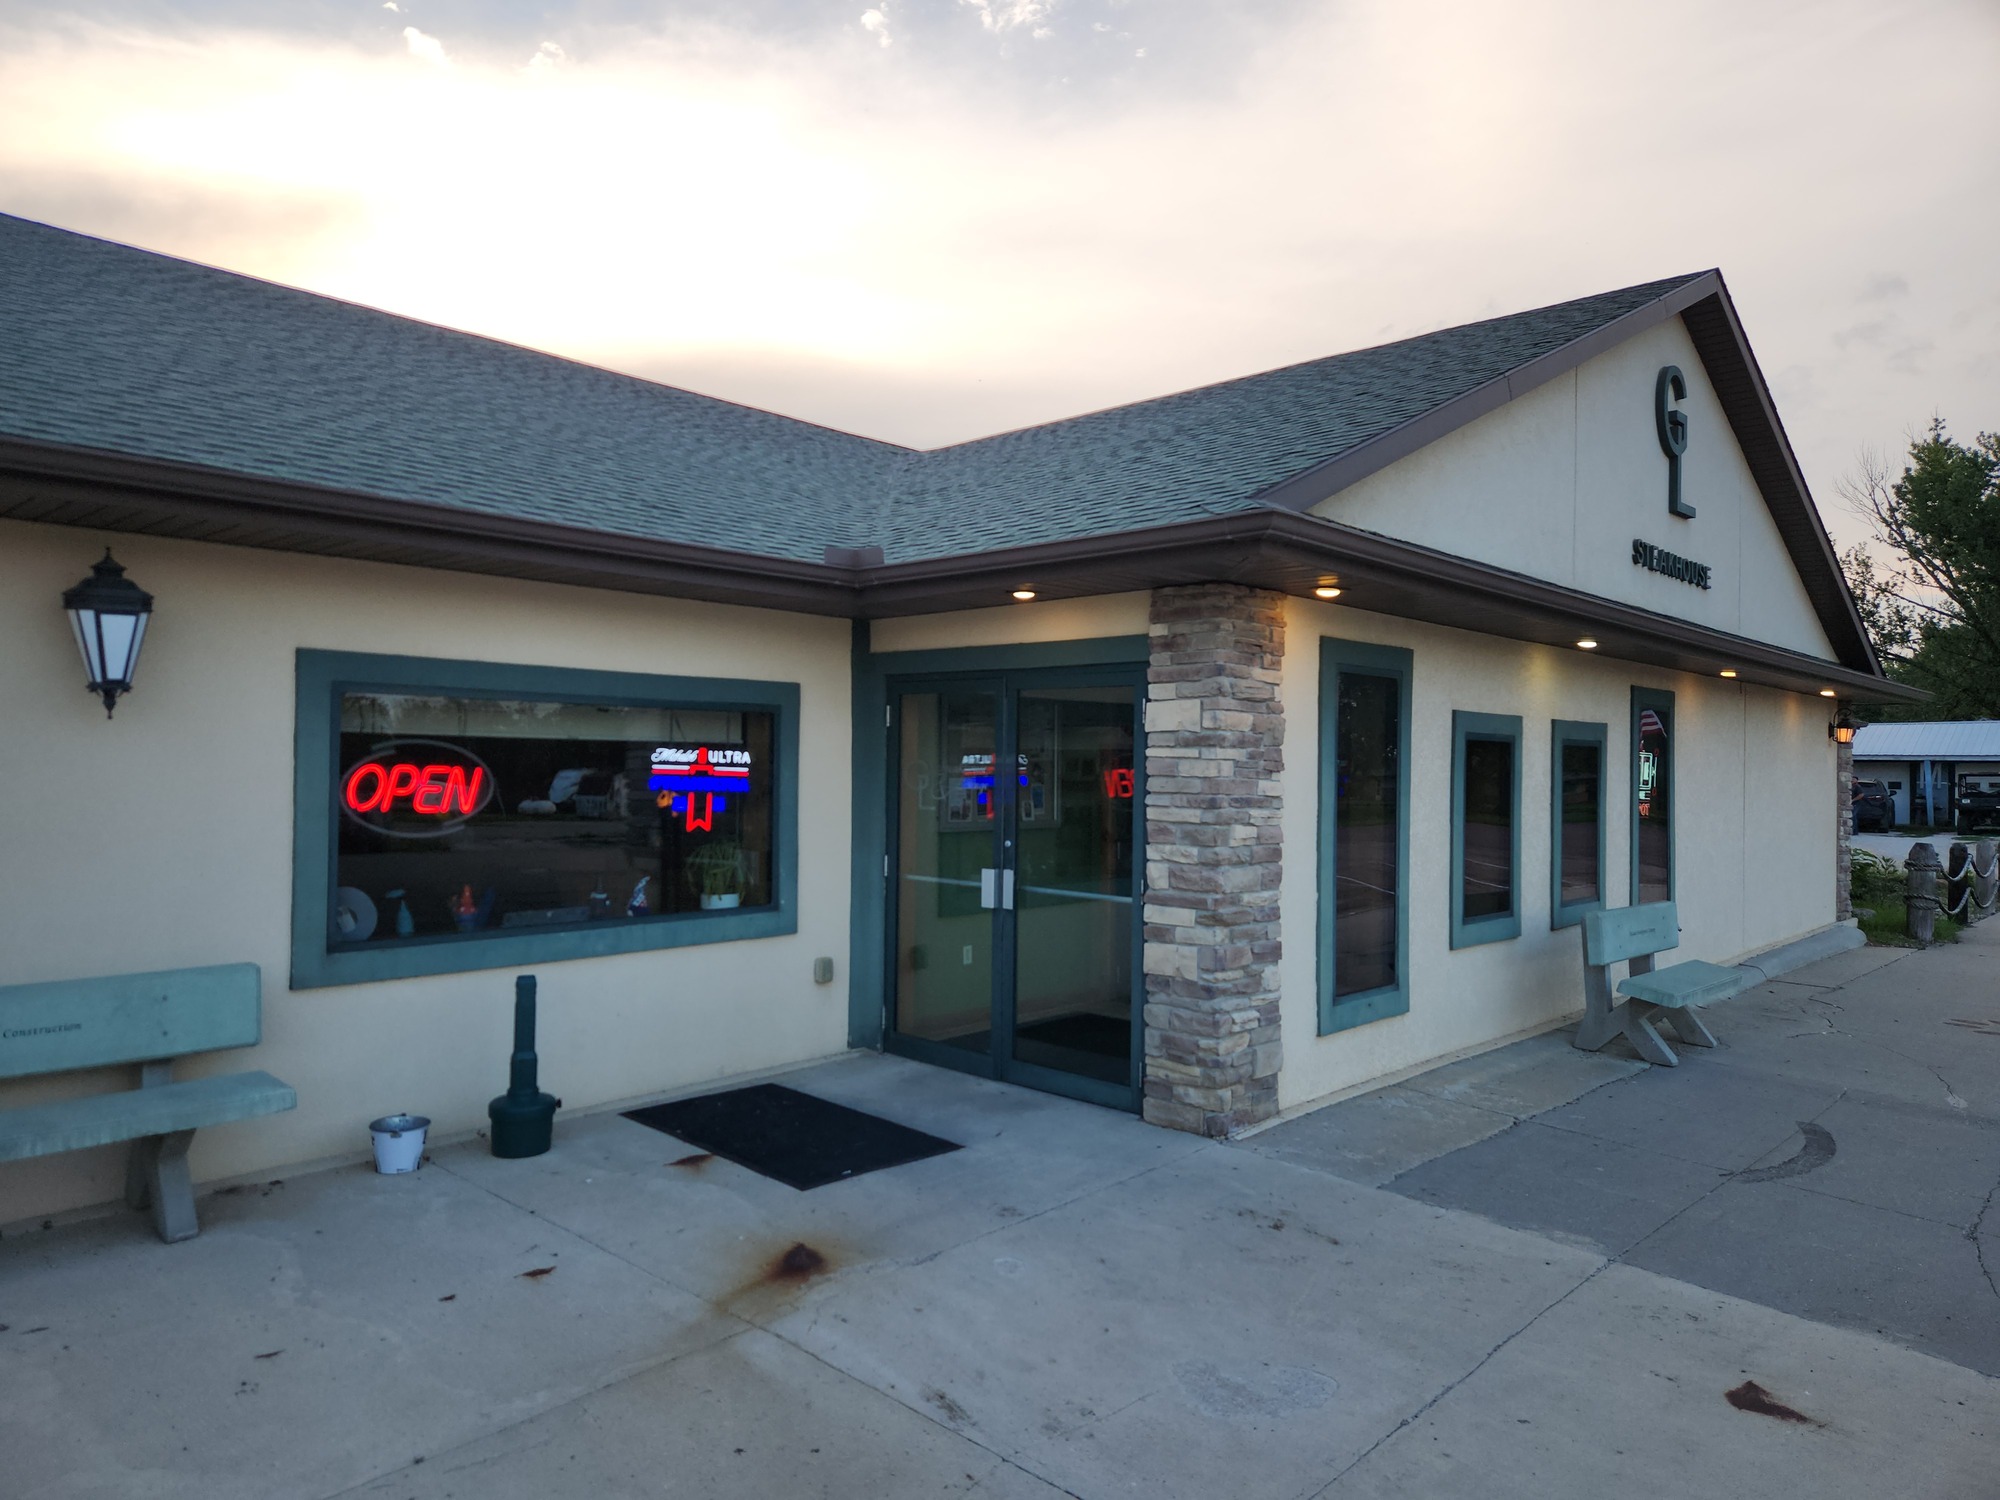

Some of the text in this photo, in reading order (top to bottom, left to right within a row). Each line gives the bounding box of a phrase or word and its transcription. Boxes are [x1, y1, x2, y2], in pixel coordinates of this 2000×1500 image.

[1632, 539, 1712, 590] STEAKHOUSE
[708, 750, 751, 764] ULTRA
[347, 763, 483, 815] OPEN
